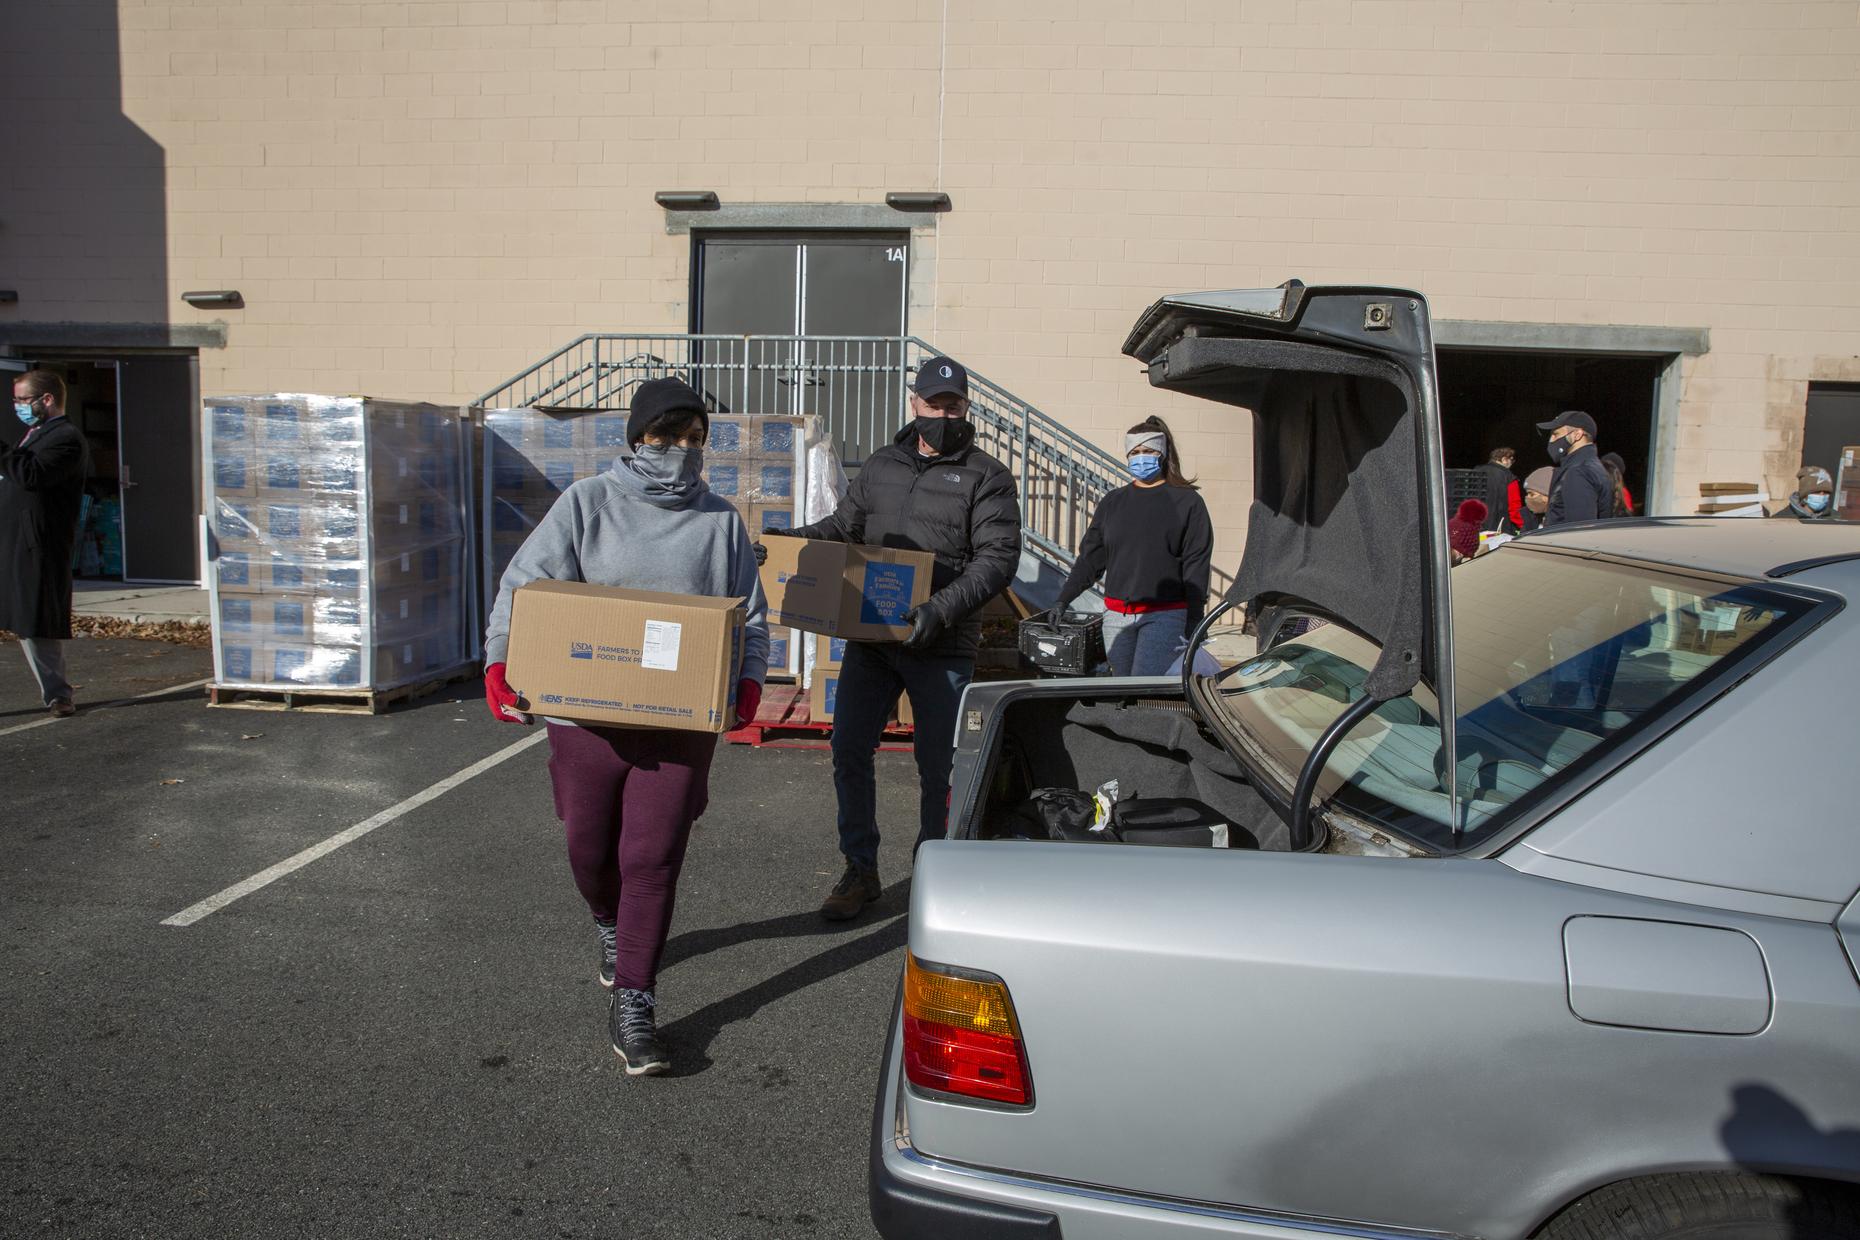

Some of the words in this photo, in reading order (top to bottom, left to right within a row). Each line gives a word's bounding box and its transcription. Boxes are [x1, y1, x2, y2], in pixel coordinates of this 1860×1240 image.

[885, 247, 904, 261] 1A
[875, 600, 897, 609] FOOD
[877, 608, 893, 617] BOX
[571, 641, 593, 651] USDA
[597, 646, 629, 655] FARMERS
[631, 648, 640, 656] TO
[617, 655, 632, 663] BOX
[580, 697, 623, 707] REFRIGERATED
[658, 705, 678, 713] RETAIL
